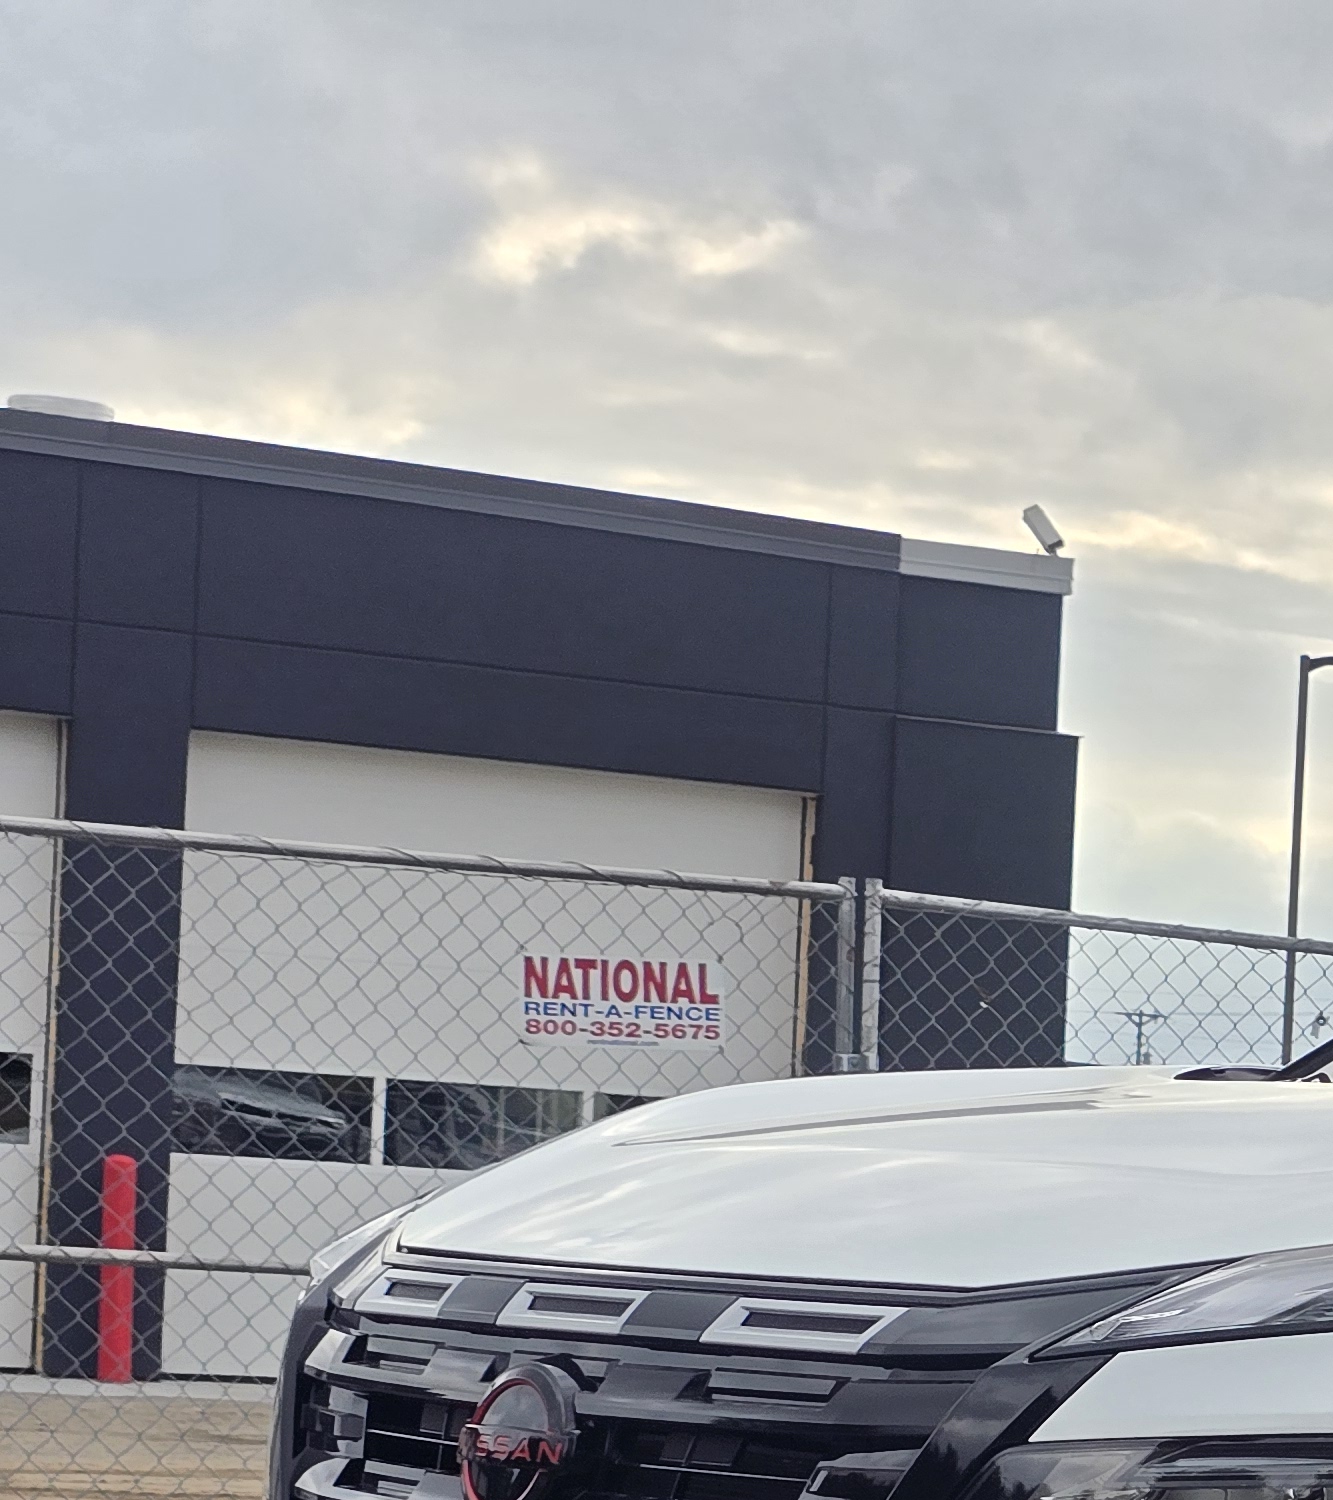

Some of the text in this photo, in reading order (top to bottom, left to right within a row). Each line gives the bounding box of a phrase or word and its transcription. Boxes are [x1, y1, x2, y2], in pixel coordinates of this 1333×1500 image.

[524, 956, 719, 1004] NATIONAL
[524, 1002, 721, 1022] RENT-A-FENCE
[525, 1019, 720, 1040] 800-352-5675
[464, 1433, 564, 1465] SSAN
